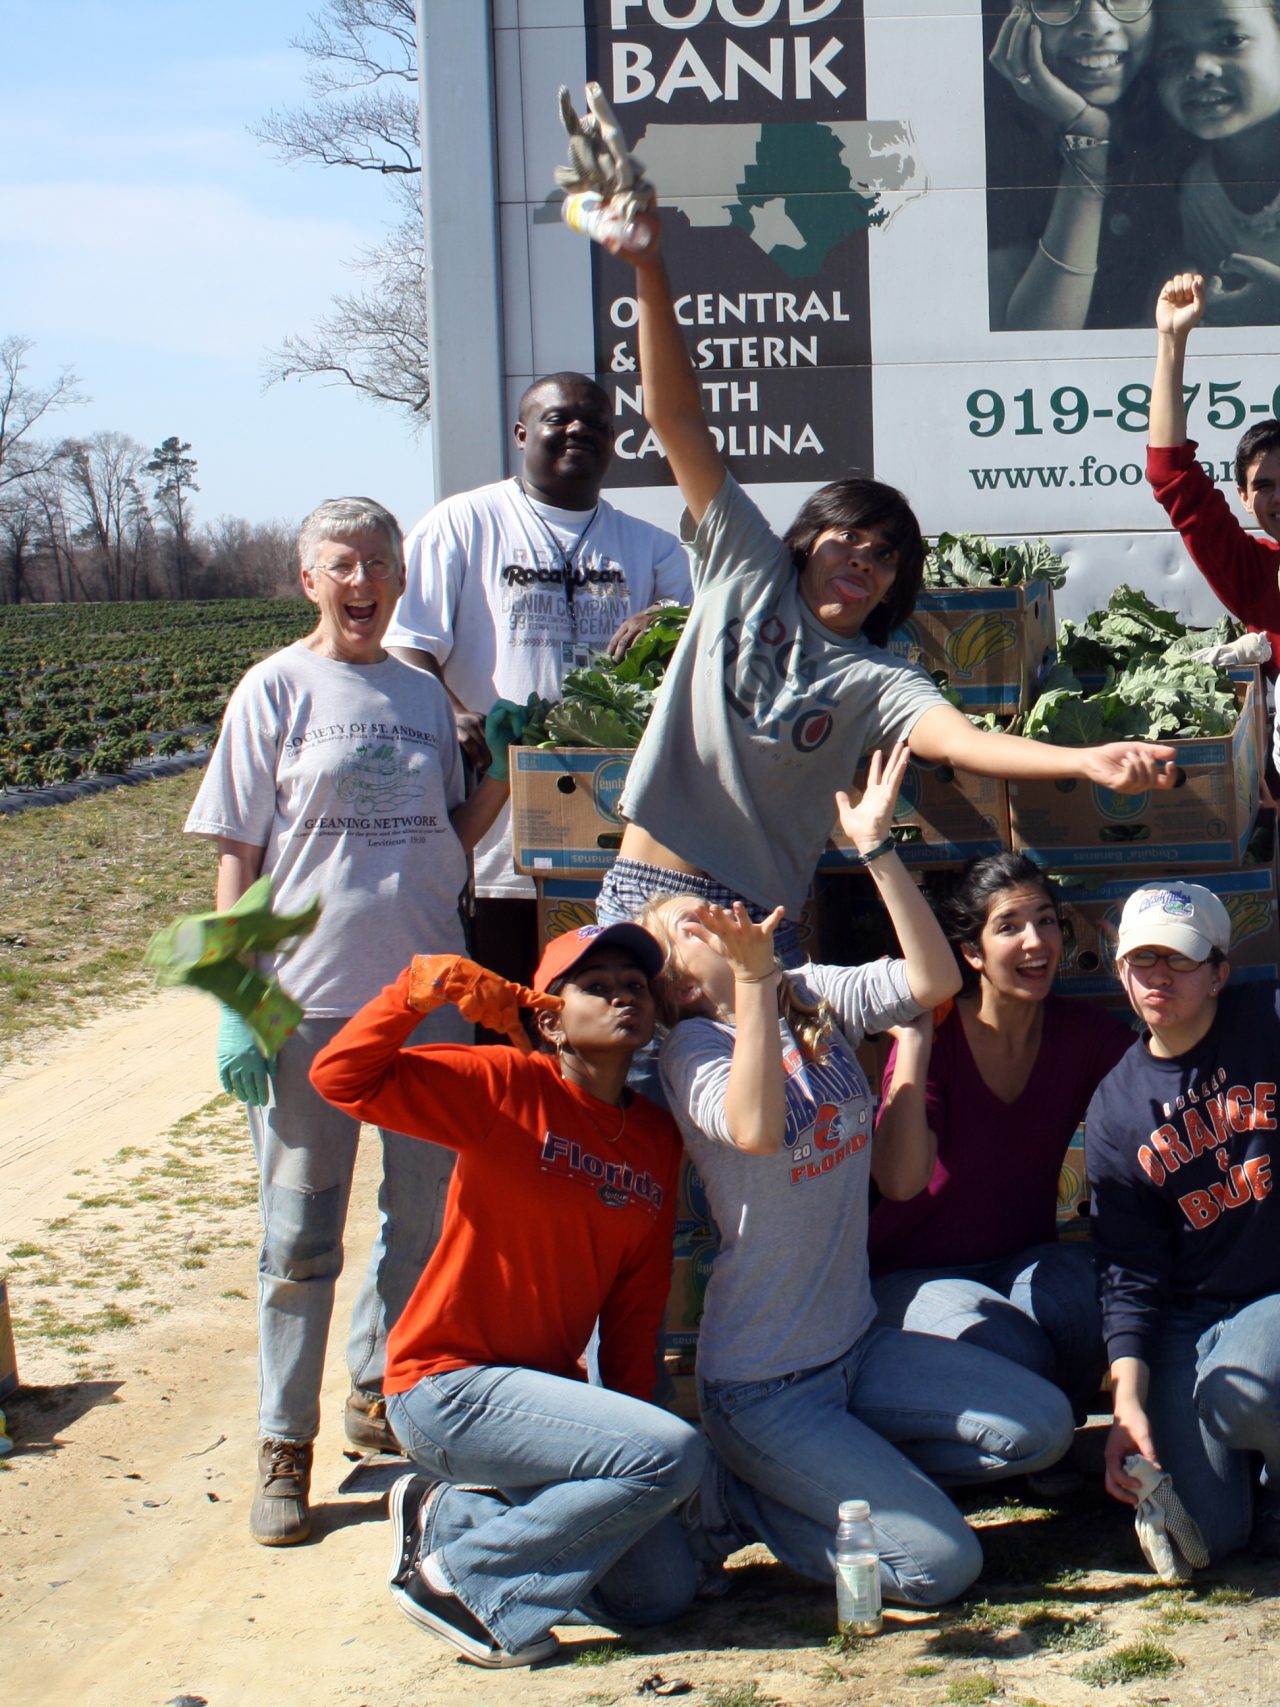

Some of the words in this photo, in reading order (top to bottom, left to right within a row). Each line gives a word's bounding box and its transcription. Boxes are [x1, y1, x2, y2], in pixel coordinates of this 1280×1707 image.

[611, 36, 848, 104] BANK
[610, 296, 640, 328] O
[673, 290, 850, 326] CENTRAL
[610, 341, 636, 373] &
[690, 336, 818, 370] STERN
[614, 381, 759, 416] NTH
[614, 423, 825, 460] CALINA
[557, 597, 630, 618] CMPANY
[285, 723, 346, 751] SOCIETY
[350, 723, 368, 733] OF
[371, 723, 389, 734] ST.
[373, 816, 437, 829] NETWORK
[1073, 851, 1123, 862] Bananas
[1128, 848, 1179, 861] Chiquita
[1175, 1067, 1227, 1110] BLEED
[1137, 1082, 1278, 1187] ORANGE
[540, 1131, 664, 1210] Florida
[789, 1132, 869, 1185] FLORID
[791, 1144, 812, 1162] 20
[1215, 1147, 1229, 1172] &
